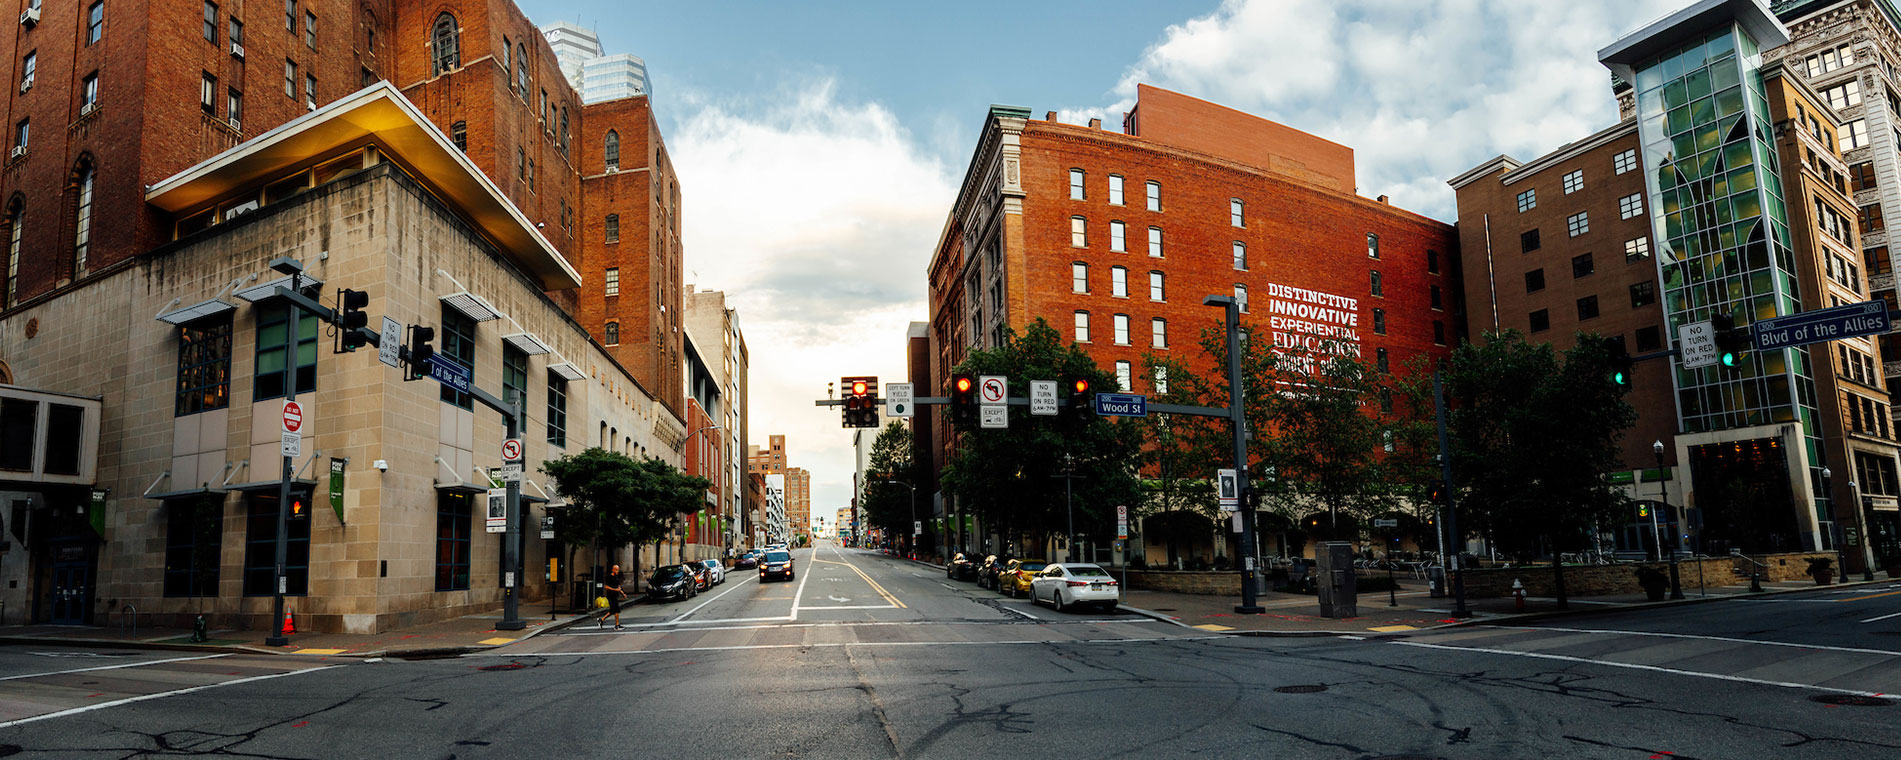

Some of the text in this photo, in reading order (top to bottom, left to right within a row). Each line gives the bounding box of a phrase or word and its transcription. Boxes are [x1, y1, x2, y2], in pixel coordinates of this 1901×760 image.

[1268, 282, 1358, 311] DISTINCTIVE
[1269, 299, 1358, 326] INNOVATIVE
[1863, 303, 1879, 313] 200
[1270, 316, 1360, 341] EXPERIENTIAL
[1690, 326, 1702, 335] NO
[1761, 317, 1883, 346] Blvd of the Allies
[1272, 331, 1361, 358] EDUCATION
[1688, 335, 1707, 345] TURN
[1685, 344, 1713, 355] ON RED
[1686, 353, 1716, 365] 6AM-7PM
[435, 367, 442, 378] of
[443, 369, 452, 382] the
[454, 375, 467, 389] Allies
[1102, 403, 1141, 413] Wood St
